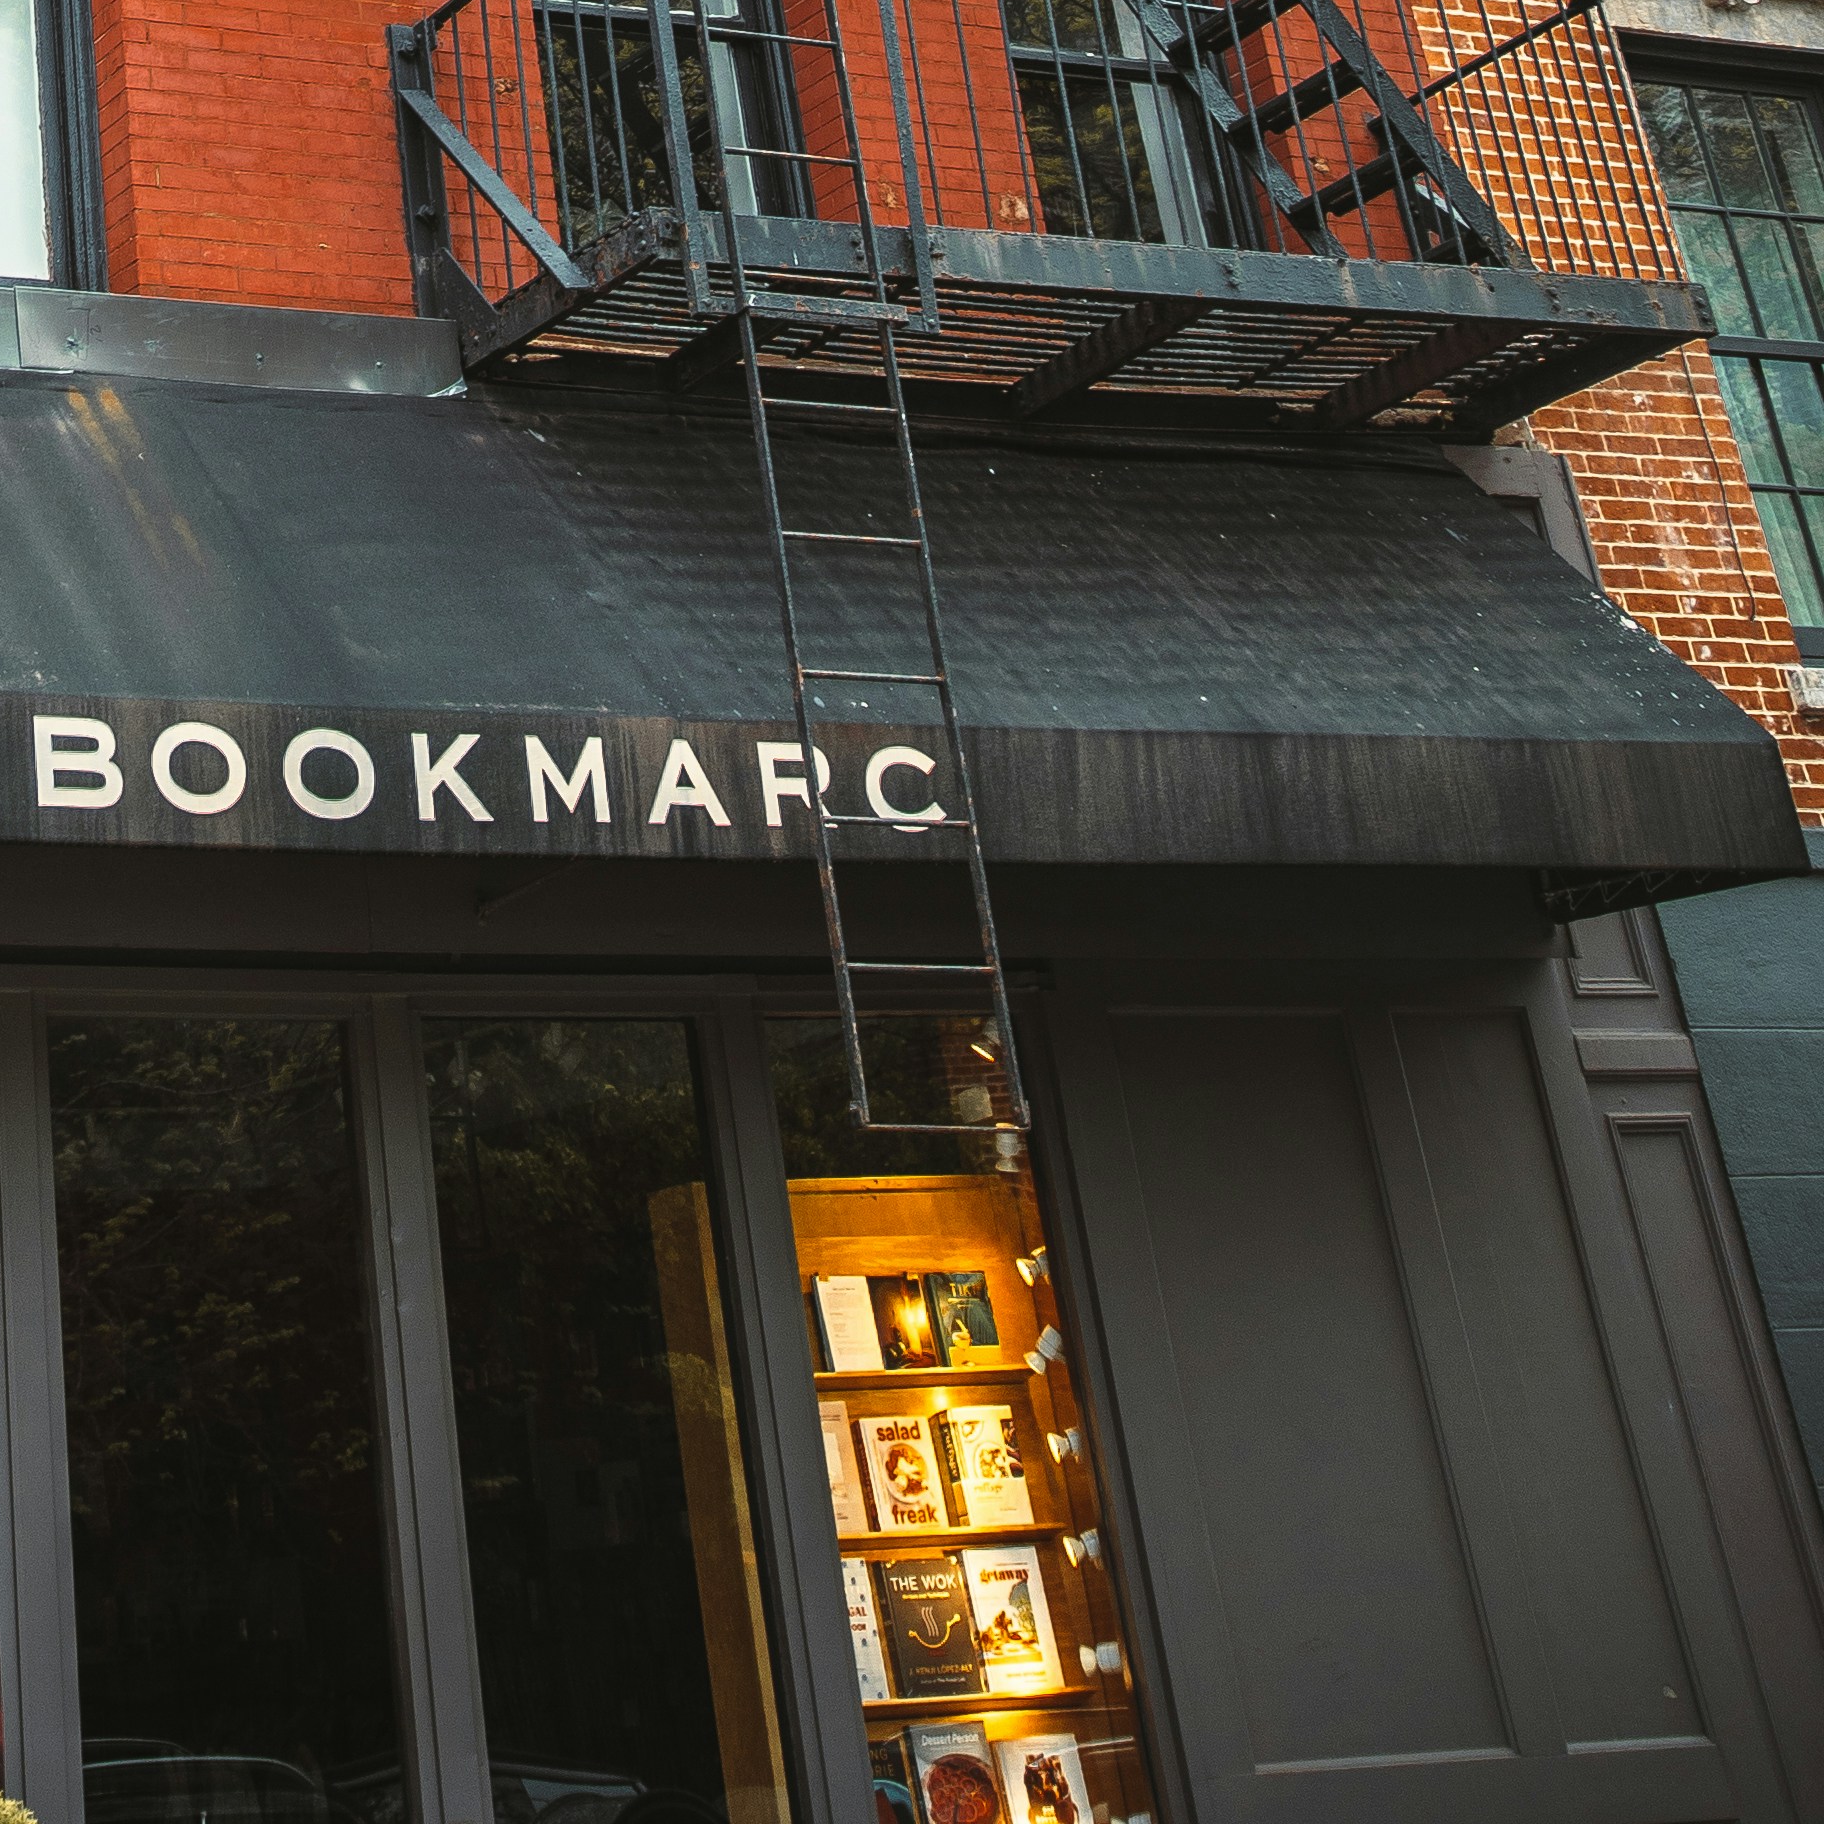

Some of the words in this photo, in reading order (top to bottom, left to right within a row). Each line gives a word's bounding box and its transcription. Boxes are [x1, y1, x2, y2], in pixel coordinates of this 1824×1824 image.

[32, 714, 949, 834] BOOKMARC
[876, 1420, 921, 1442] salad
[891, 1503, 939, 1525] freak
[889, 1575, 919, 1592] THE
[920, 1573, 958, 1591] WOK
[979, 1567, 1030, 1584] getaway
[921, 1734, 951, 1747] Dessert
[952, 1732, 979, 1745] Person
